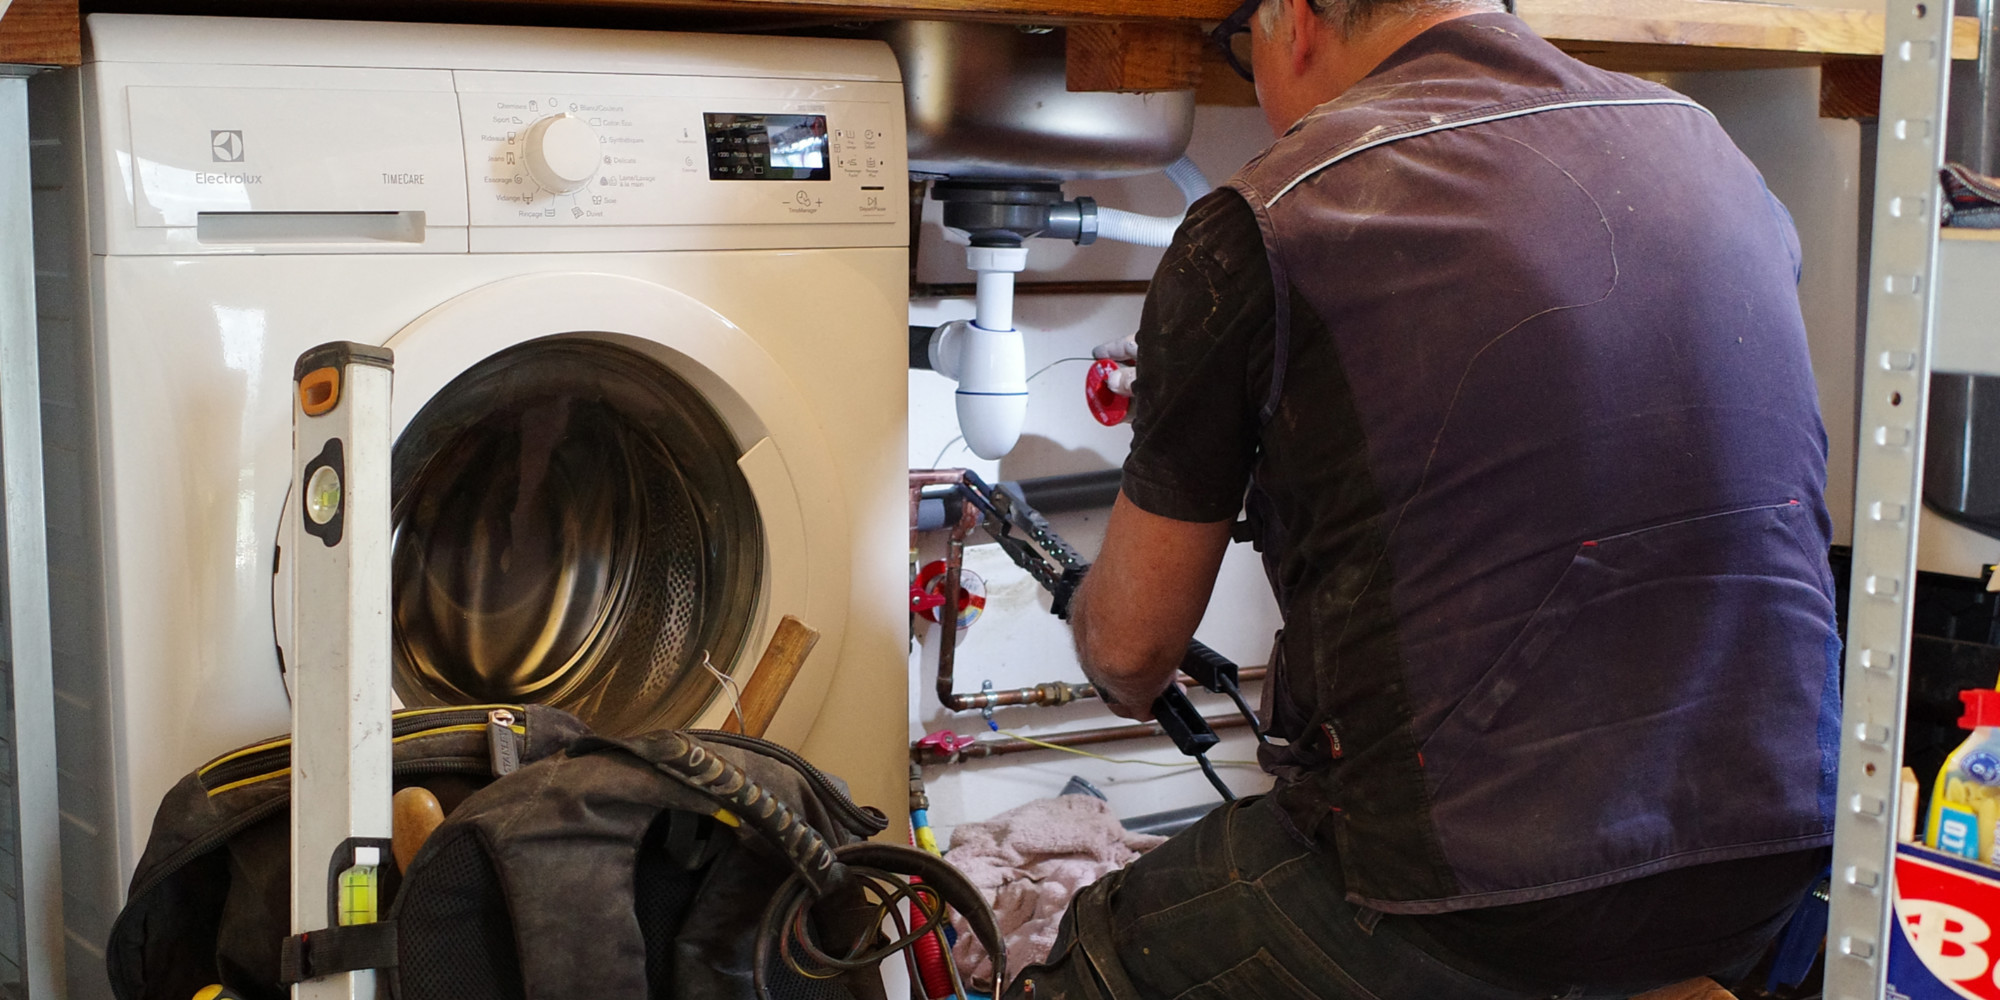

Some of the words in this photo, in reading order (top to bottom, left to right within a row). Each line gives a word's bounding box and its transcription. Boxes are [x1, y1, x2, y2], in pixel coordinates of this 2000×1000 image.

[492, 116, 511, 124] Sport
[195, 172, 263, 185] Electrolux
[496, 194, 521, 203] Vidange
[586, 210, 603, 218] Duvet
